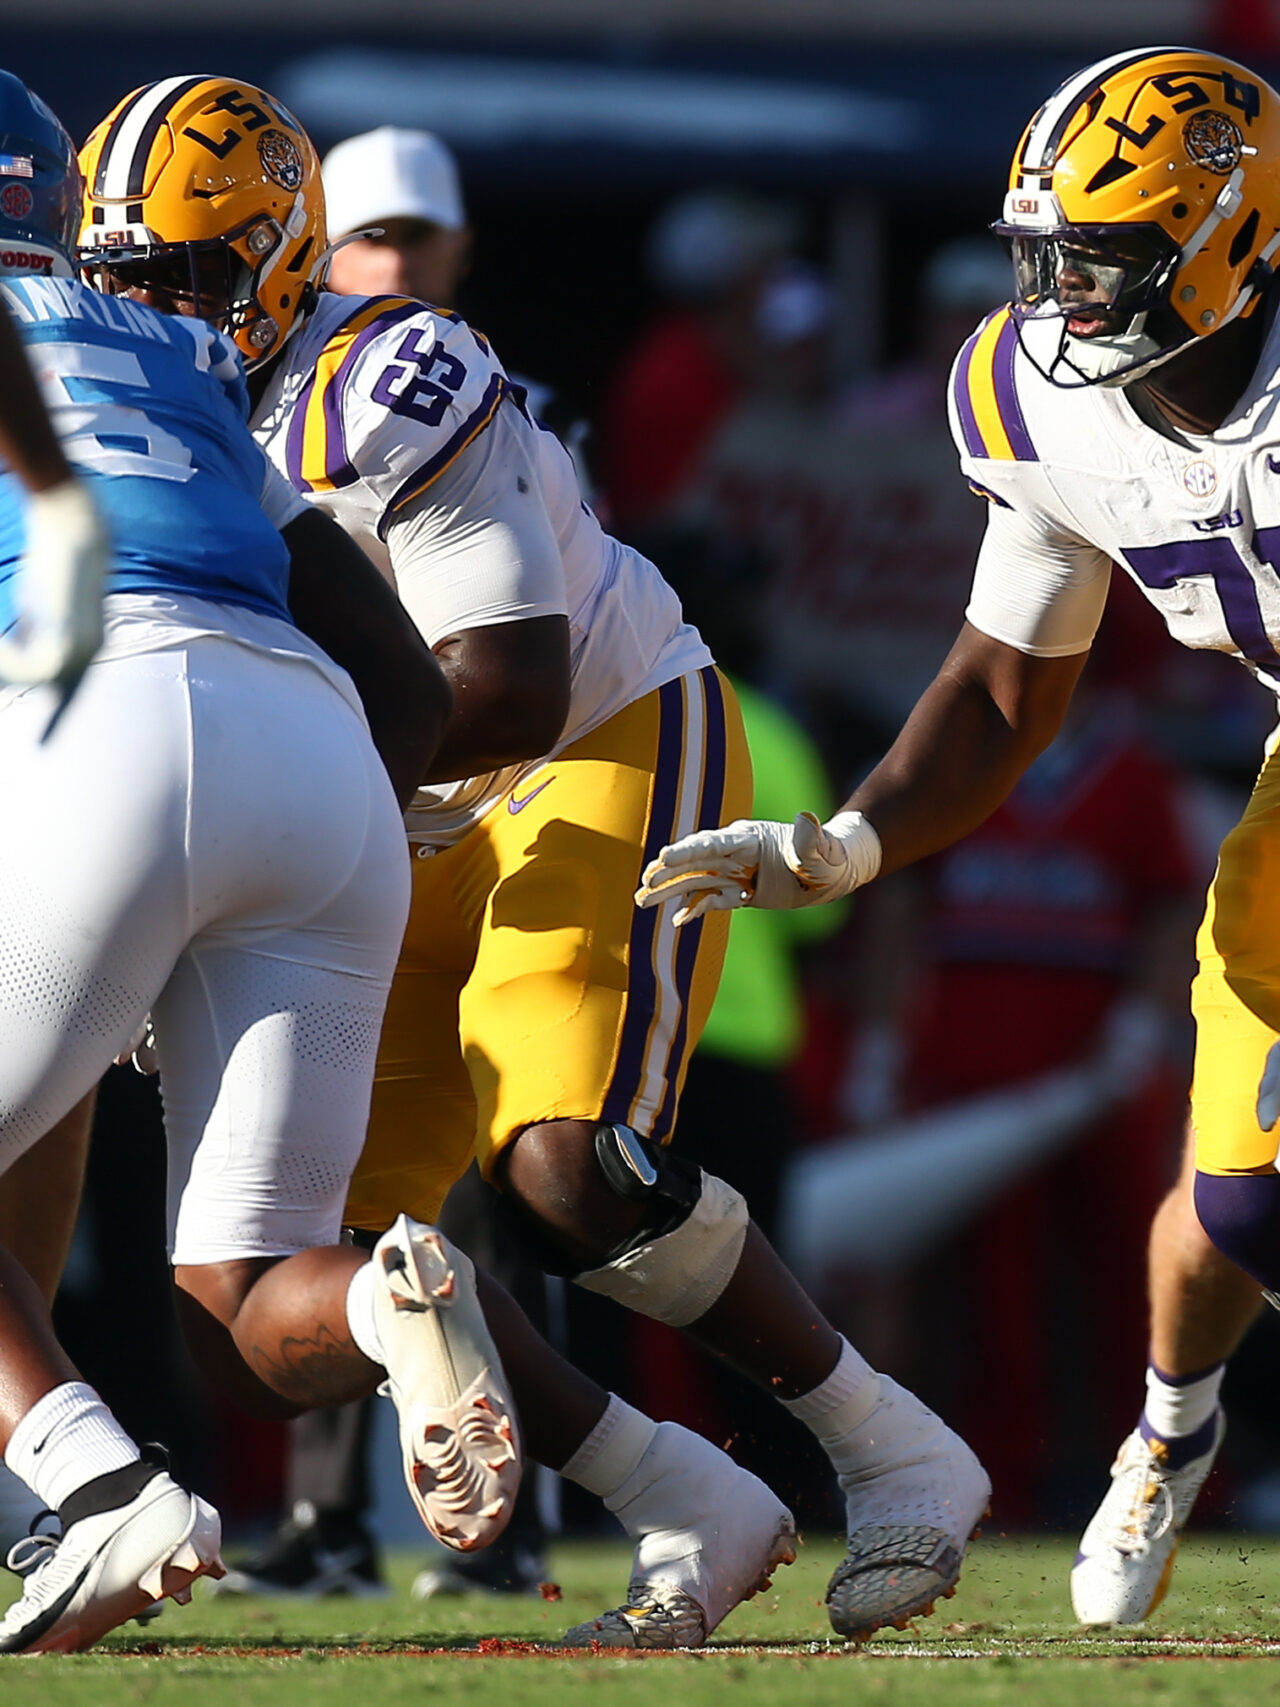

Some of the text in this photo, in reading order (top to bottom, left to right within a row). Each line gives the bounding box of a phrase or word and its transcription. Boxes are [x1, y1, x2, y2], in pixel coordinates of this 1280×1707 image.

[1011, 199, 1039, 214] LSU
[94, 230, 135, 246] LSU
[0, 250, 55, 275] ODDY
[370, 327, 468, 427] 65
[1191, 508, 1244, 532] LSU
